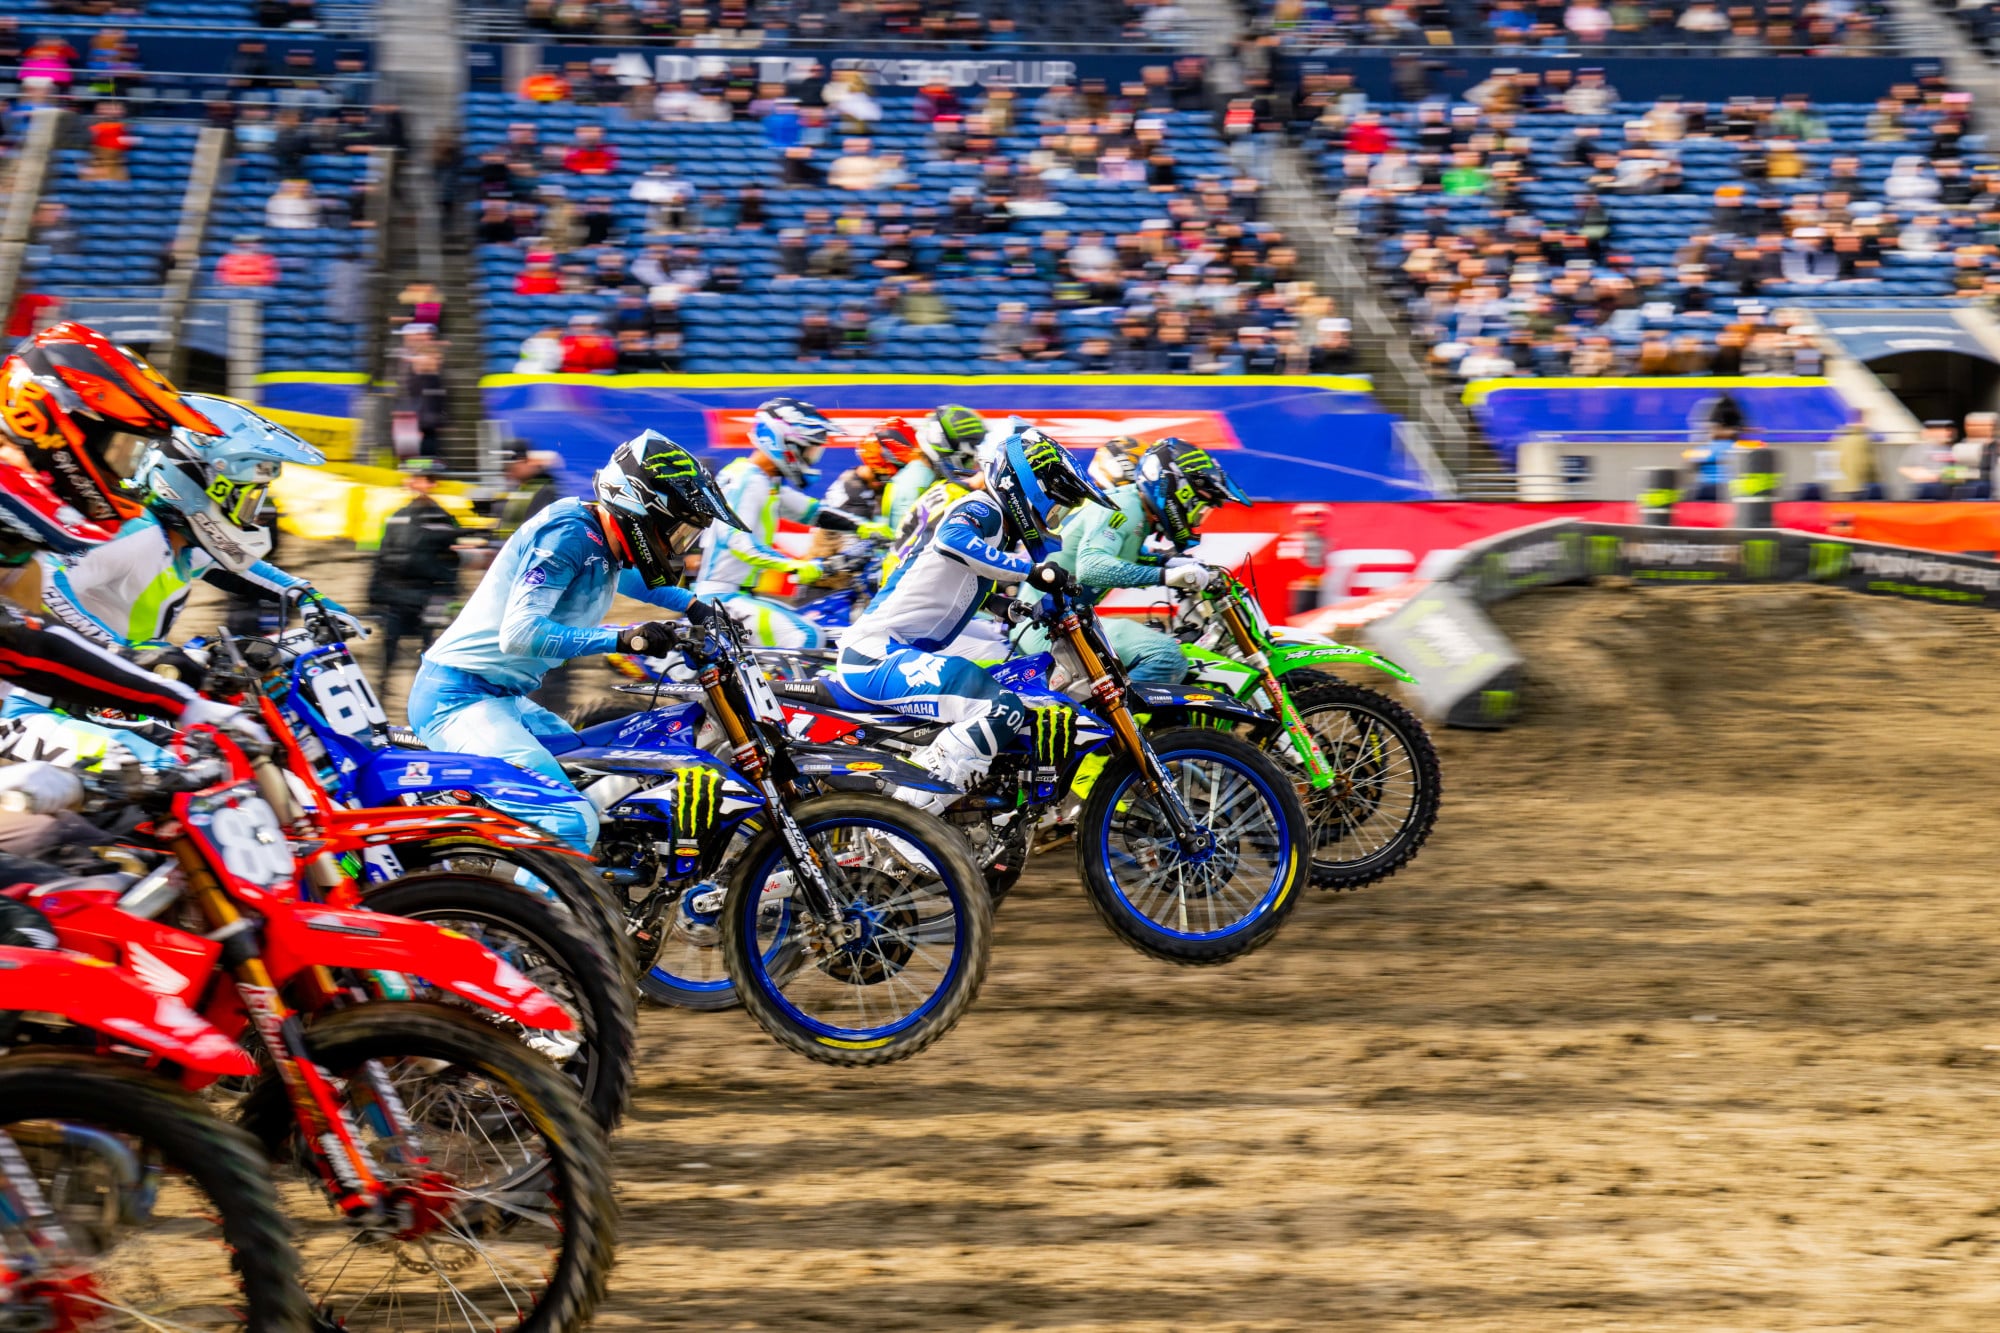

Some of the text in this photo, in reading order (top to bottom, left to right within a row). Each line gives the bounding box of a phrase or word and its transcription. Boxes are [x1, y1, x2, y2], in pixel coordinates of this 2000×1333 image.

[1010, 492, 1030, 529] MONSTER
[633, 522, 654, 564] MONSTER
[966, 535, 1017, 568] FOX
[312, 662, 387, 735] 60
[784, 683, 816, 694] YAMAHA
